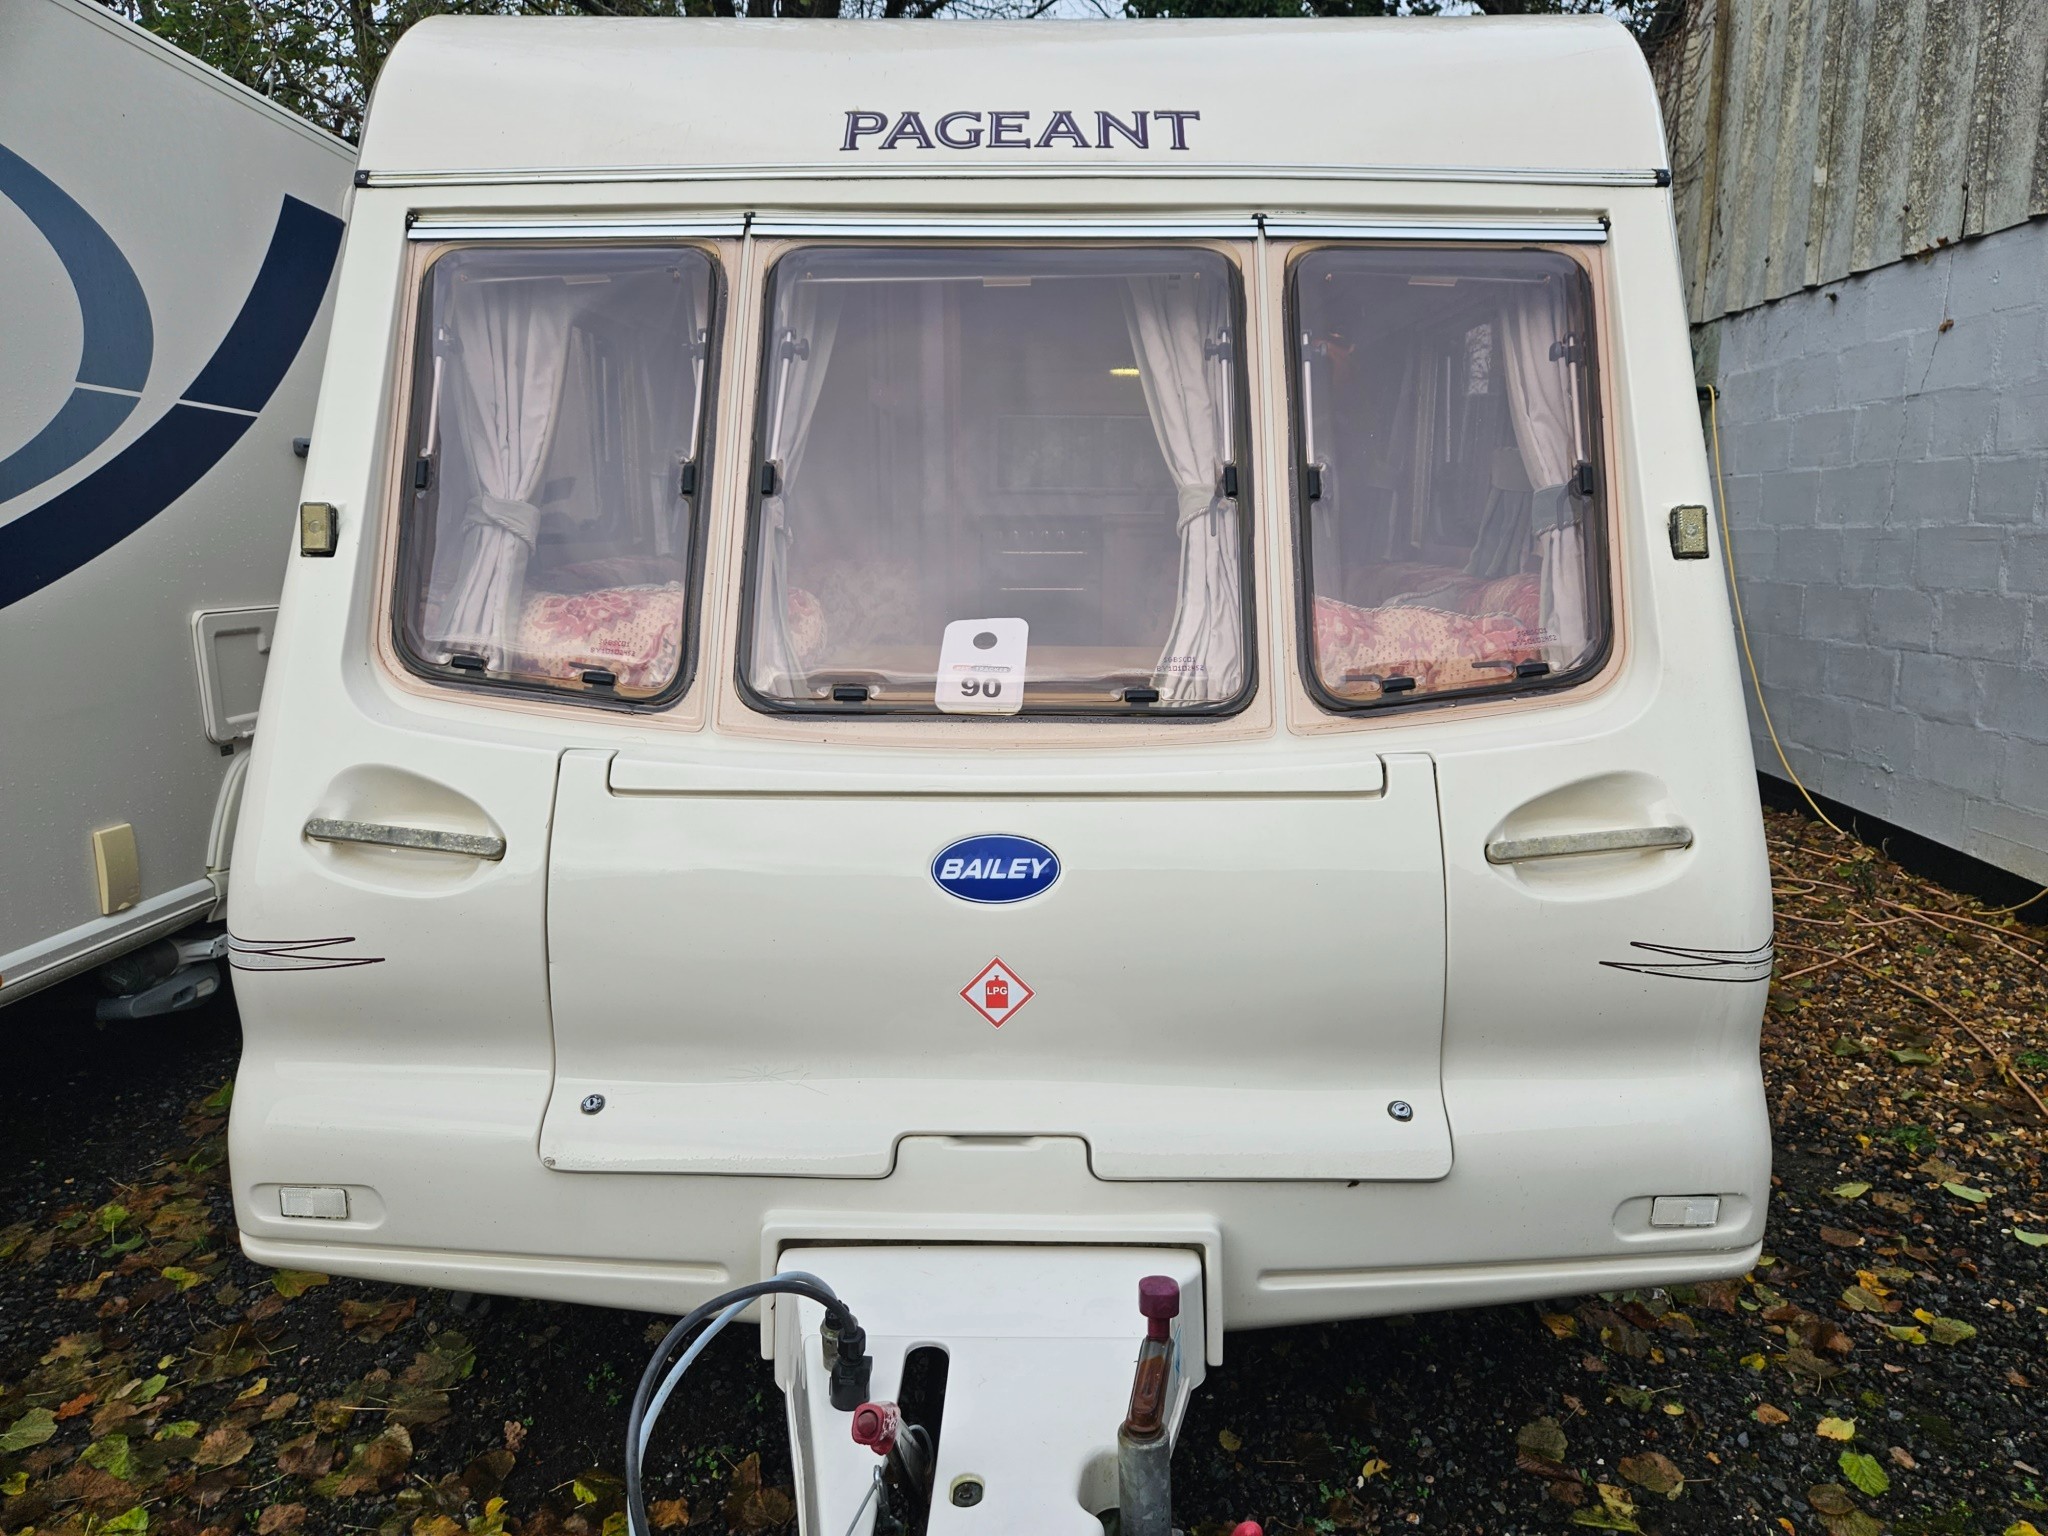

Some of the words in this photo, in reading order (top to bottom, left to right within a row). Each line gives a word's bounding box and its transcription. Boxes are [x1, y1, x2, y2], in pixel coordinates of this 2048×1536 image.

[840, 110, 1200, 150] PAGEANT
[960, 677, 1002, 698] 90
[940, 858, 1051, 879] BAILEY
[986, 986, 1008, 995] LPG
